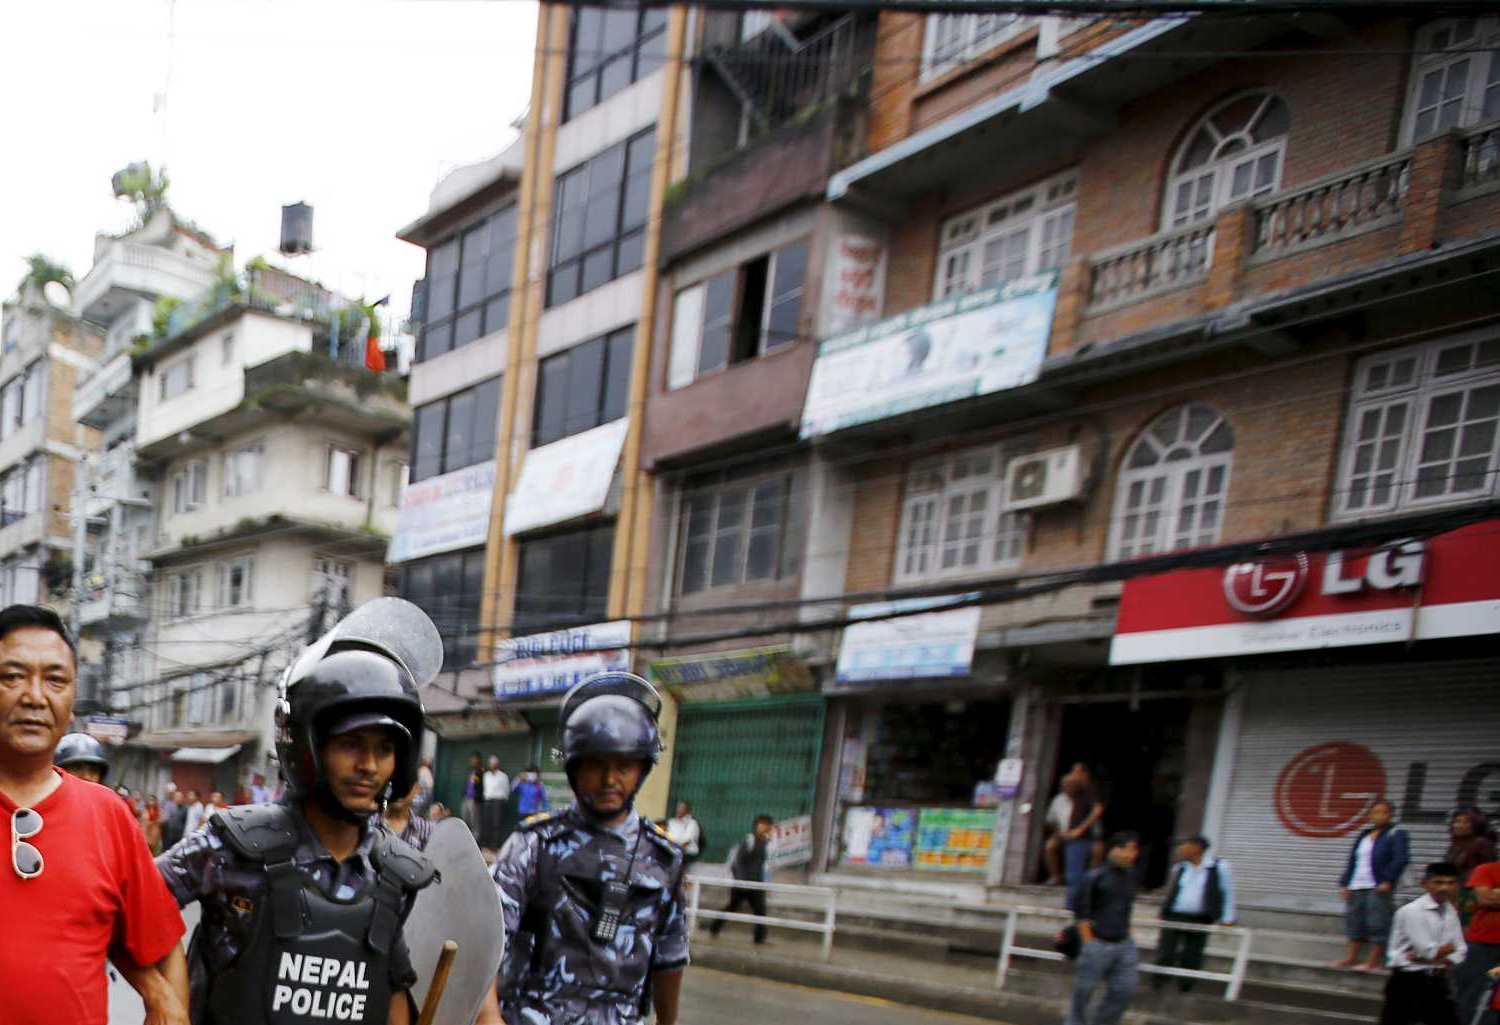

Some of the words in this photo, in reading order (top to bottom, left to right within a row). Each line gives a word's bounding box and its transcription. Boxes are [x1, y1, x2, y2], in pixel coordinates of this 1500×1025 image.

[1320, 537, 1425, 596] LG
[277, 951, 370, 990] NEPAL
[272, 984, 368, 1021] POLICE
